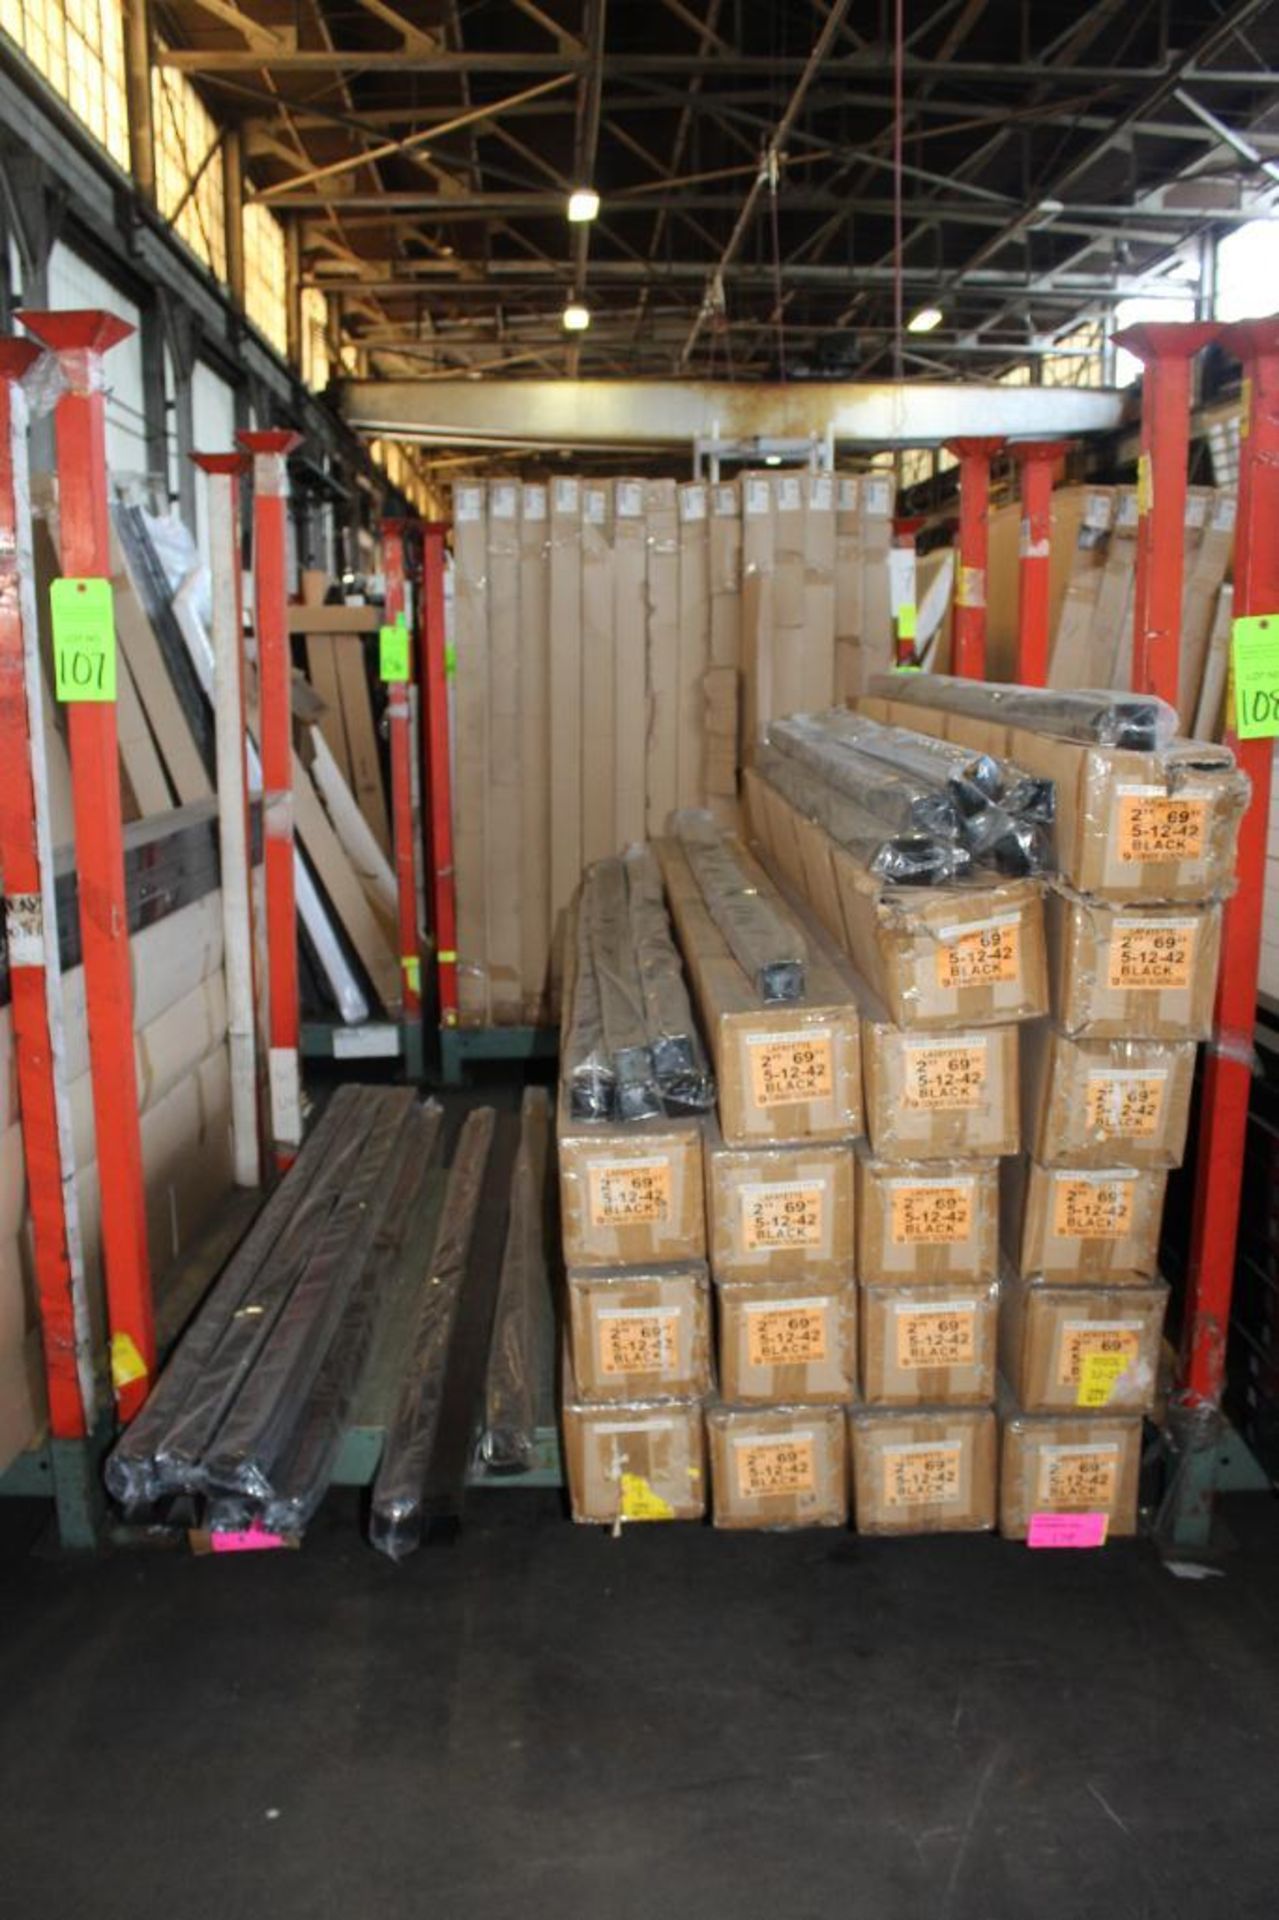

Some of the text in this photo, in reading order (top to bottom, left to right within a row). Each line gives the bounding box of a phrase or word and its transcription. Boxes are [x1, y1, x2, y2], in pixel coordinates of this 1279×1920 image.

[61, 651, 105, 690] 107
[1132, 825, 1199, 838] 5-12-42
[1132, 840, 1186, 851] BLACK
[950, 946, 1012, 964] 5-12-42
[1121, 951, 1185, 964] 5-12-42
[950, 964, 1001, 977] BLACK
[1121, 965, 1172, 976] BLACK
[763, 1064, 825, 1081] 5-12-42
[917, 1071, 981, 1087] 5-12-42
[766, 1079, 816, 1093] BLACK
[919, 1087, 970, 1098] BLACK
[603, 1189, 663, 1204] 5-12-42
[604, 1203, 653, 1216] BLACK
[905, 1210, 967, 1222] 5-12-42
[1067, 1205, 1128, 1218] 5-12-42
[755, 1213, 817, 1228] 5-12-42
[756, 1228, 807, 1240] BLACK
[905, 1224, 954, 1234] BLACK
[759, 1329, 821, 1344] 5-12-42
[909, 1333, 969, 1346] 5-12-42
[614, 1352, 659, 1362] BLACK
[761, 1344, 810, 1357] BLACK
[910, 1347, 958, 1357] BLACK
[749, 1462, 809, 1476] 5-12-42
[750, 1476, 797, 1487] BLACK
[895, 1471, 955, 1484] 5-12-42
[1050, 1474, 1109, 1486] 5-12-42
[897, 1484, 944, 1495] BLACK
[1051, 1487, 1097, 1496] BLACK
